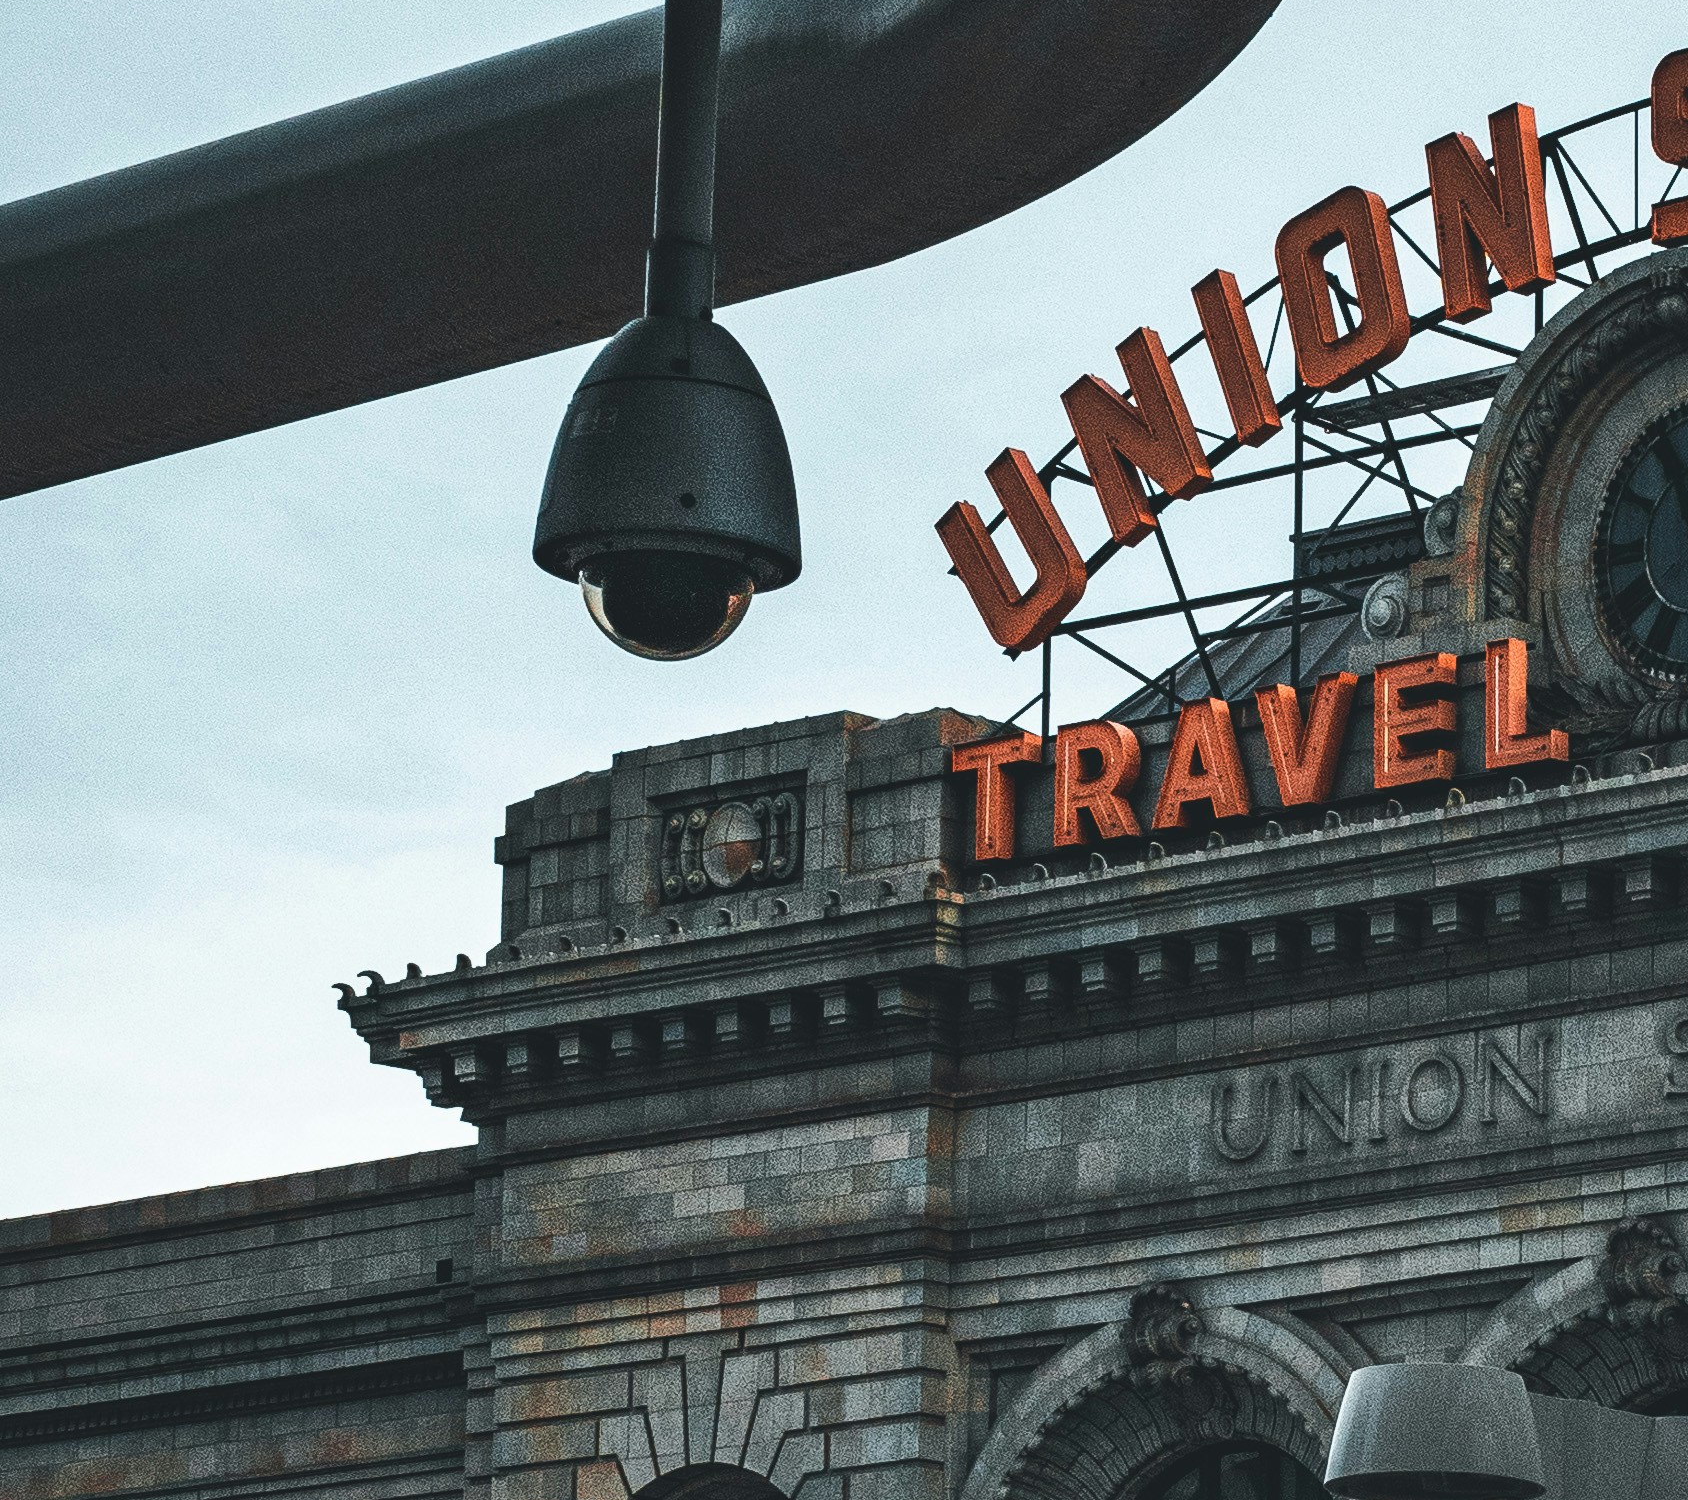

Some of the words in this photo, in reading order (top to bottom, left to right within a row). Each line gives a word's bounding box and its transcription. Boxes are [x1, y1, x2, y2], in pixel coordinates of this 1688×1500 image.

[935, 102, 1556, 652] UNION
[952, 639, 1570, 861] TRAVEL
[1211, 1028, 1554, 1162] UNION
